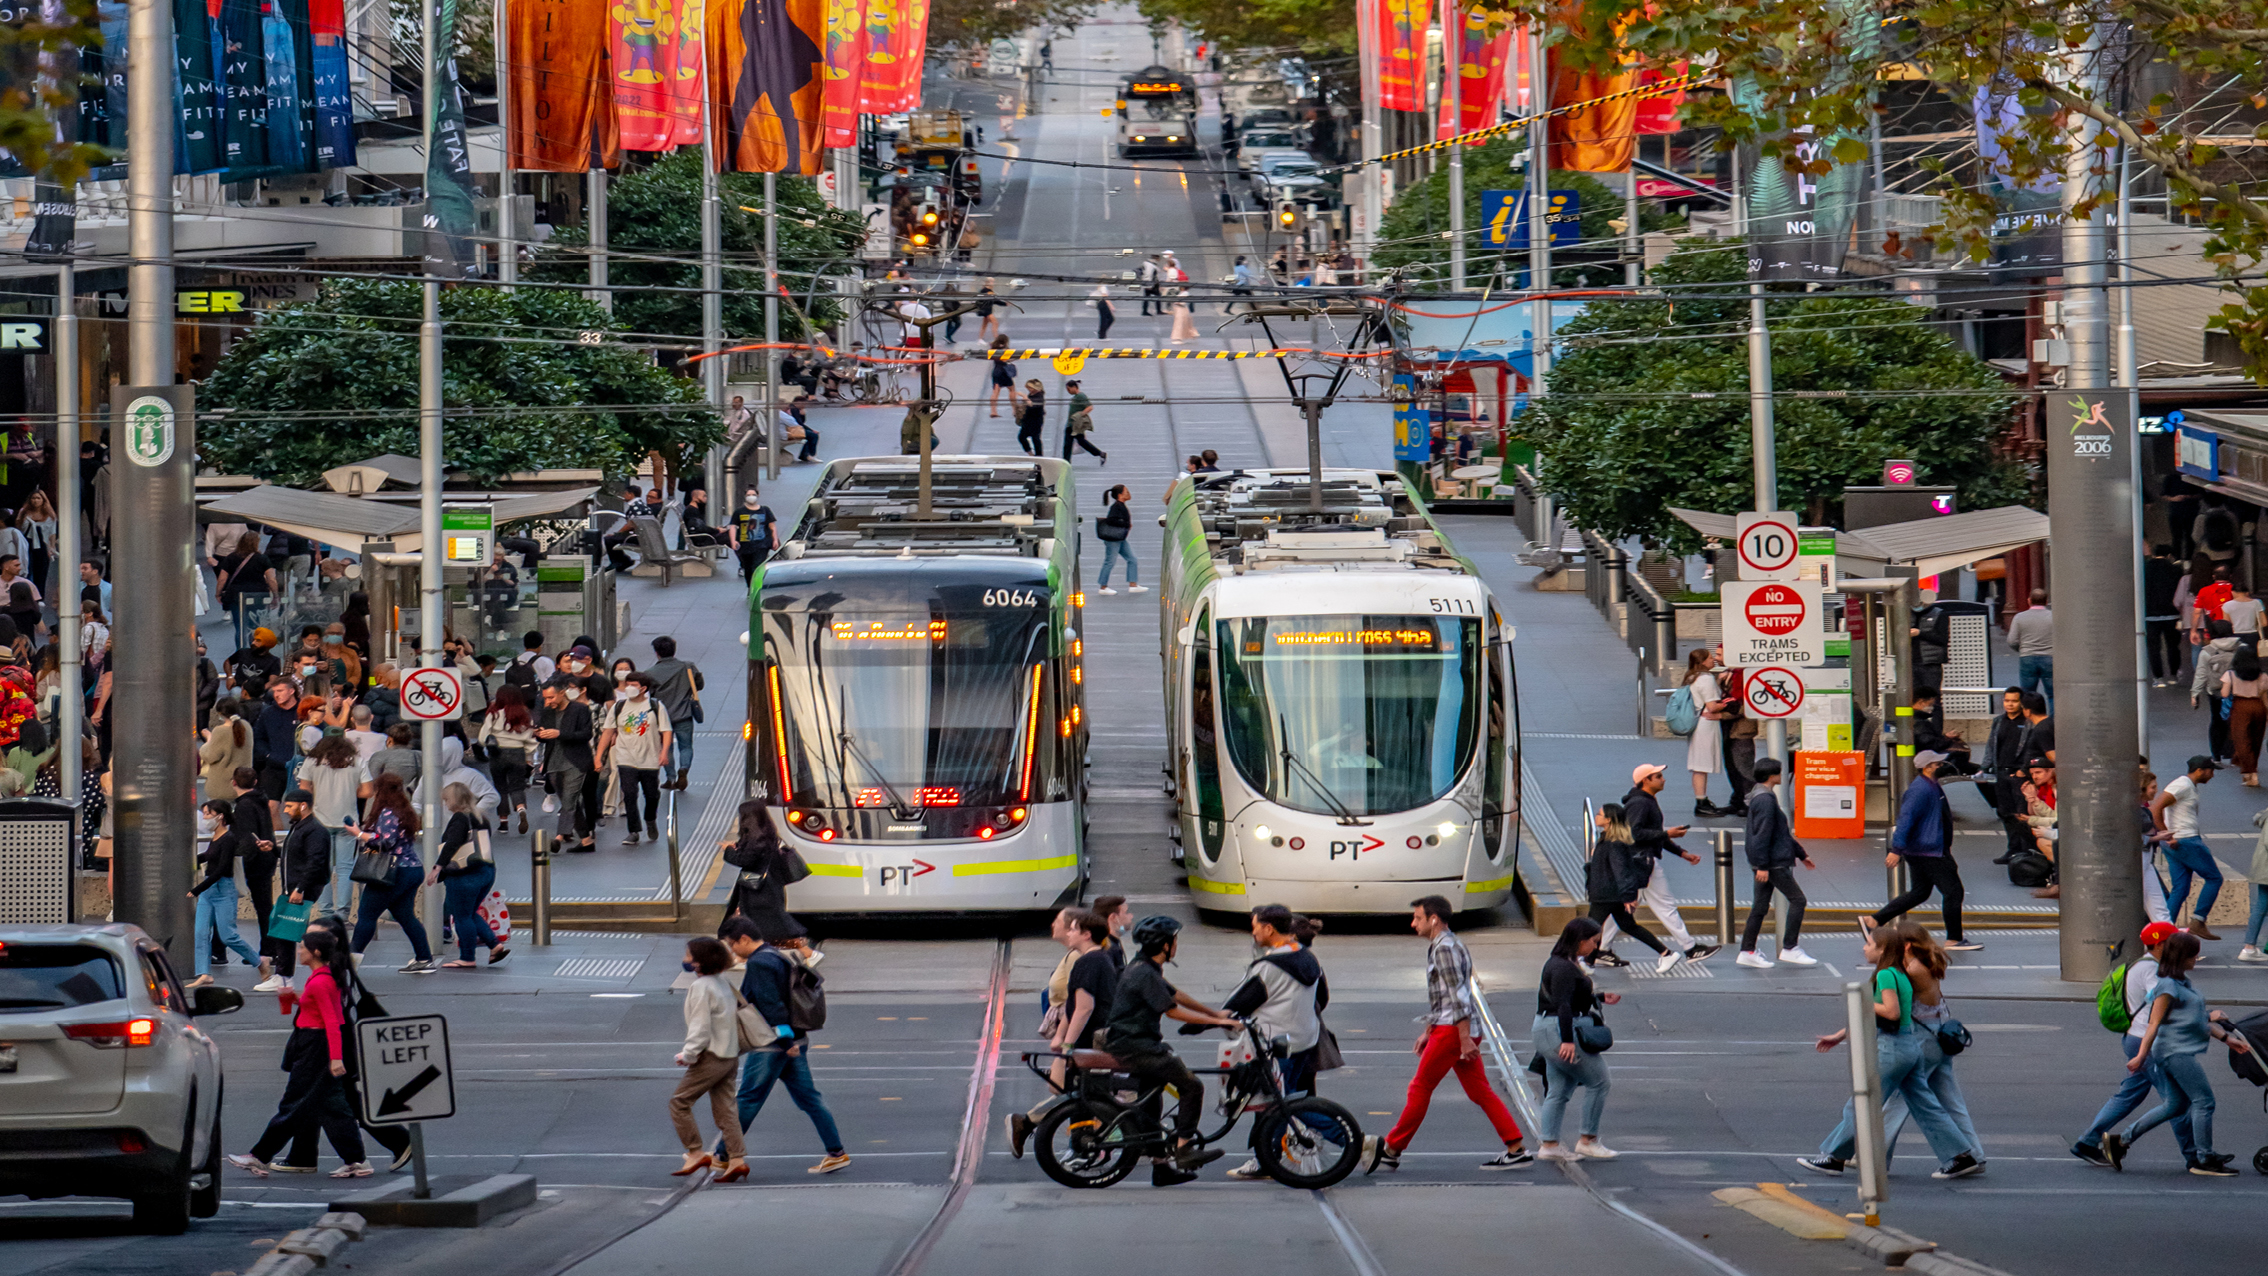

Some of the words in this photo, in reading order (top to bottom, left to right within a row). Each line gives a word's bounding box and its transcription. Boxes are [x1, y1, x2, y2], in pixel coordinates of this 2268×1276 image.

[535, 0, 556, 149] ILTON
[580, 331, 602, 344] 33
[2074, 440, 2112, 454] 2006
[1753, 534, 1784, 559] 10
[982, 588, 1038, 608] 6064
[1765, 591, 1785, 603] NO
[1429, 598, 1475, 614] 5111
[1754, 616, 1798, 628] ENTRY
[1750, 638, 1799, 650] TRAMS
[1739, 651, 1810, 663] EXCEPTED
[1805, 757, 1826, 765] Tram
[1805, 773, 1840, 781] changes
[376, 1023, 431, 1043] KEEP
[382, 1045, 430, 1065] LEFT
